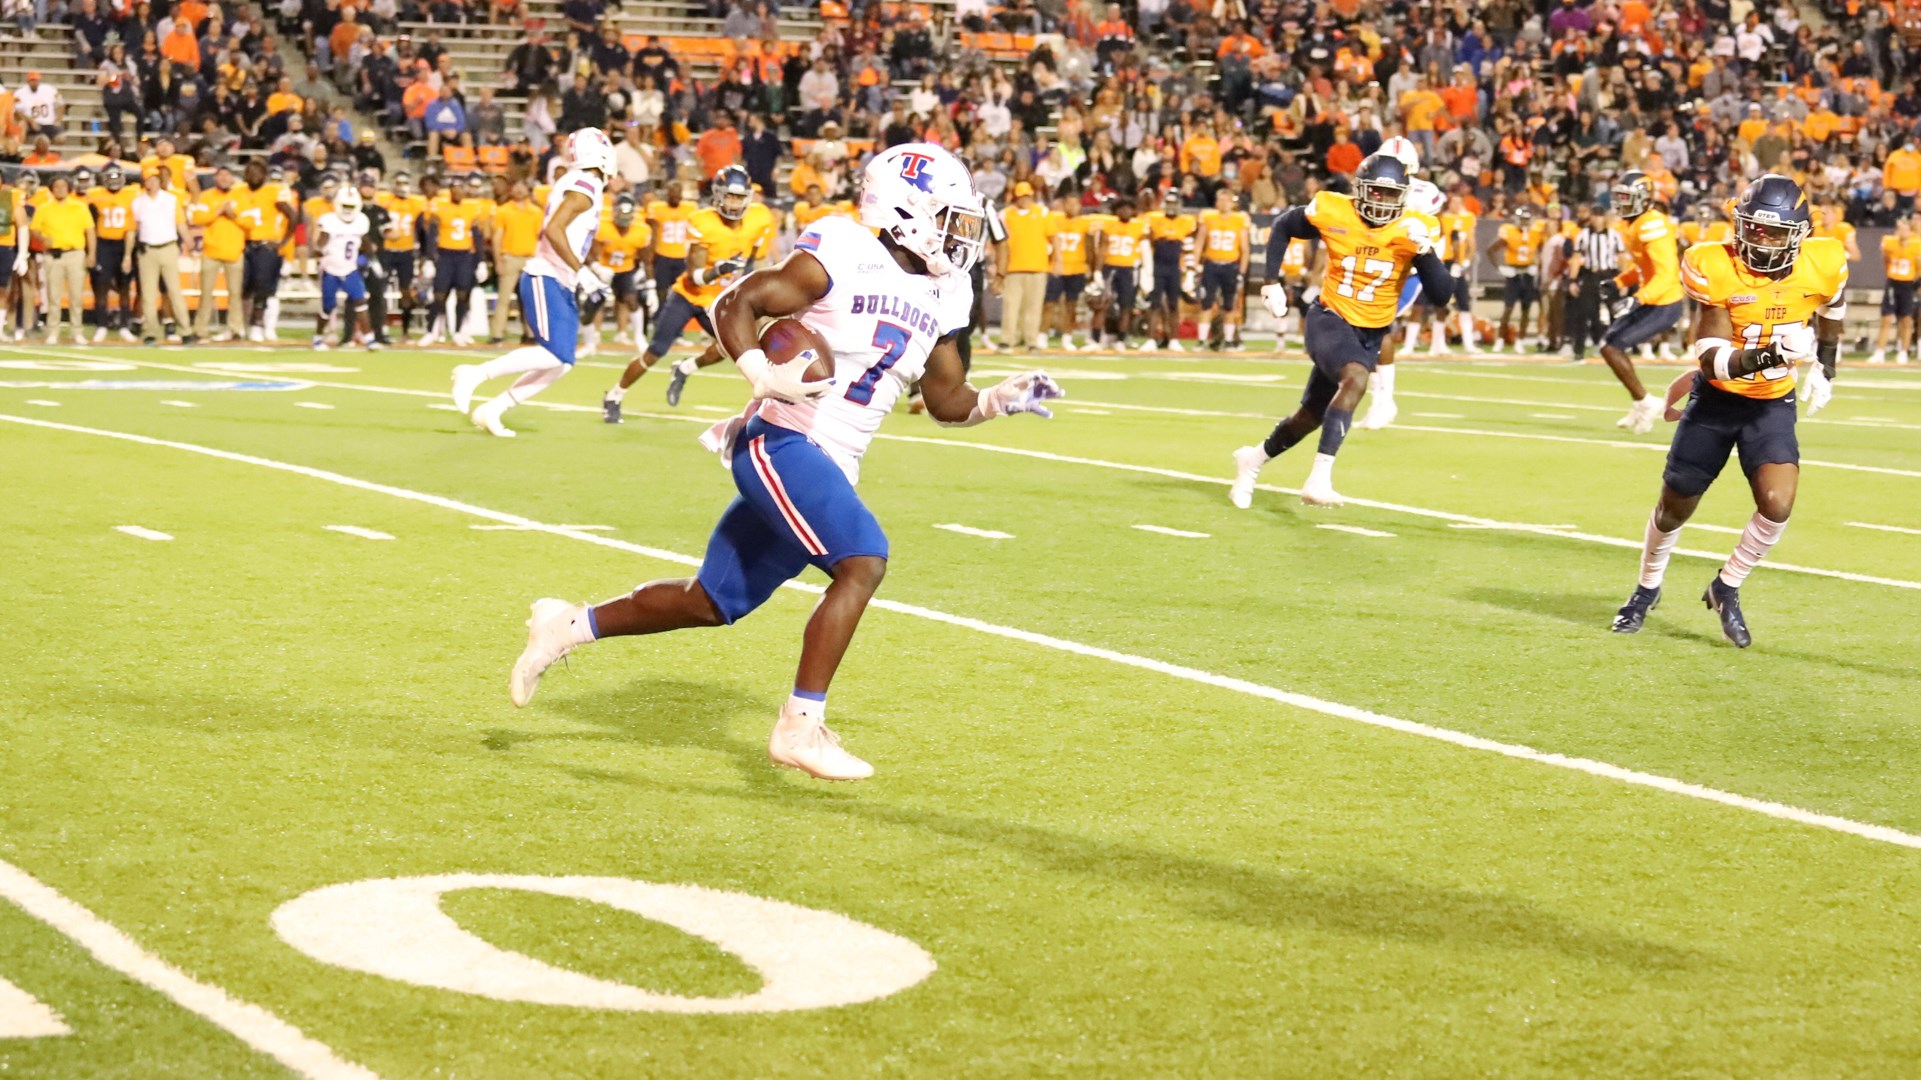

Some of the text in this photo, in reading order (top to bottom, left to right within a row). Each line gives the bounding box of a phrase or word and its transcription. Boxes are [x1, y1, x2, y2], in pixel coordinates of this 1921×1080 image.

[102, 207, 126, 228] 10
[451, 219, 465, 240] 3
[345, 241, 354, 259] 6
[1355, 246, 1379, 256] UTEP
[1337, 256, 1395, 302] 17
[851, 295, 939, 338] BULLDOGS
[1765, 307, 1787, 320] UTEP
[844, 320, 913, 406] 7
